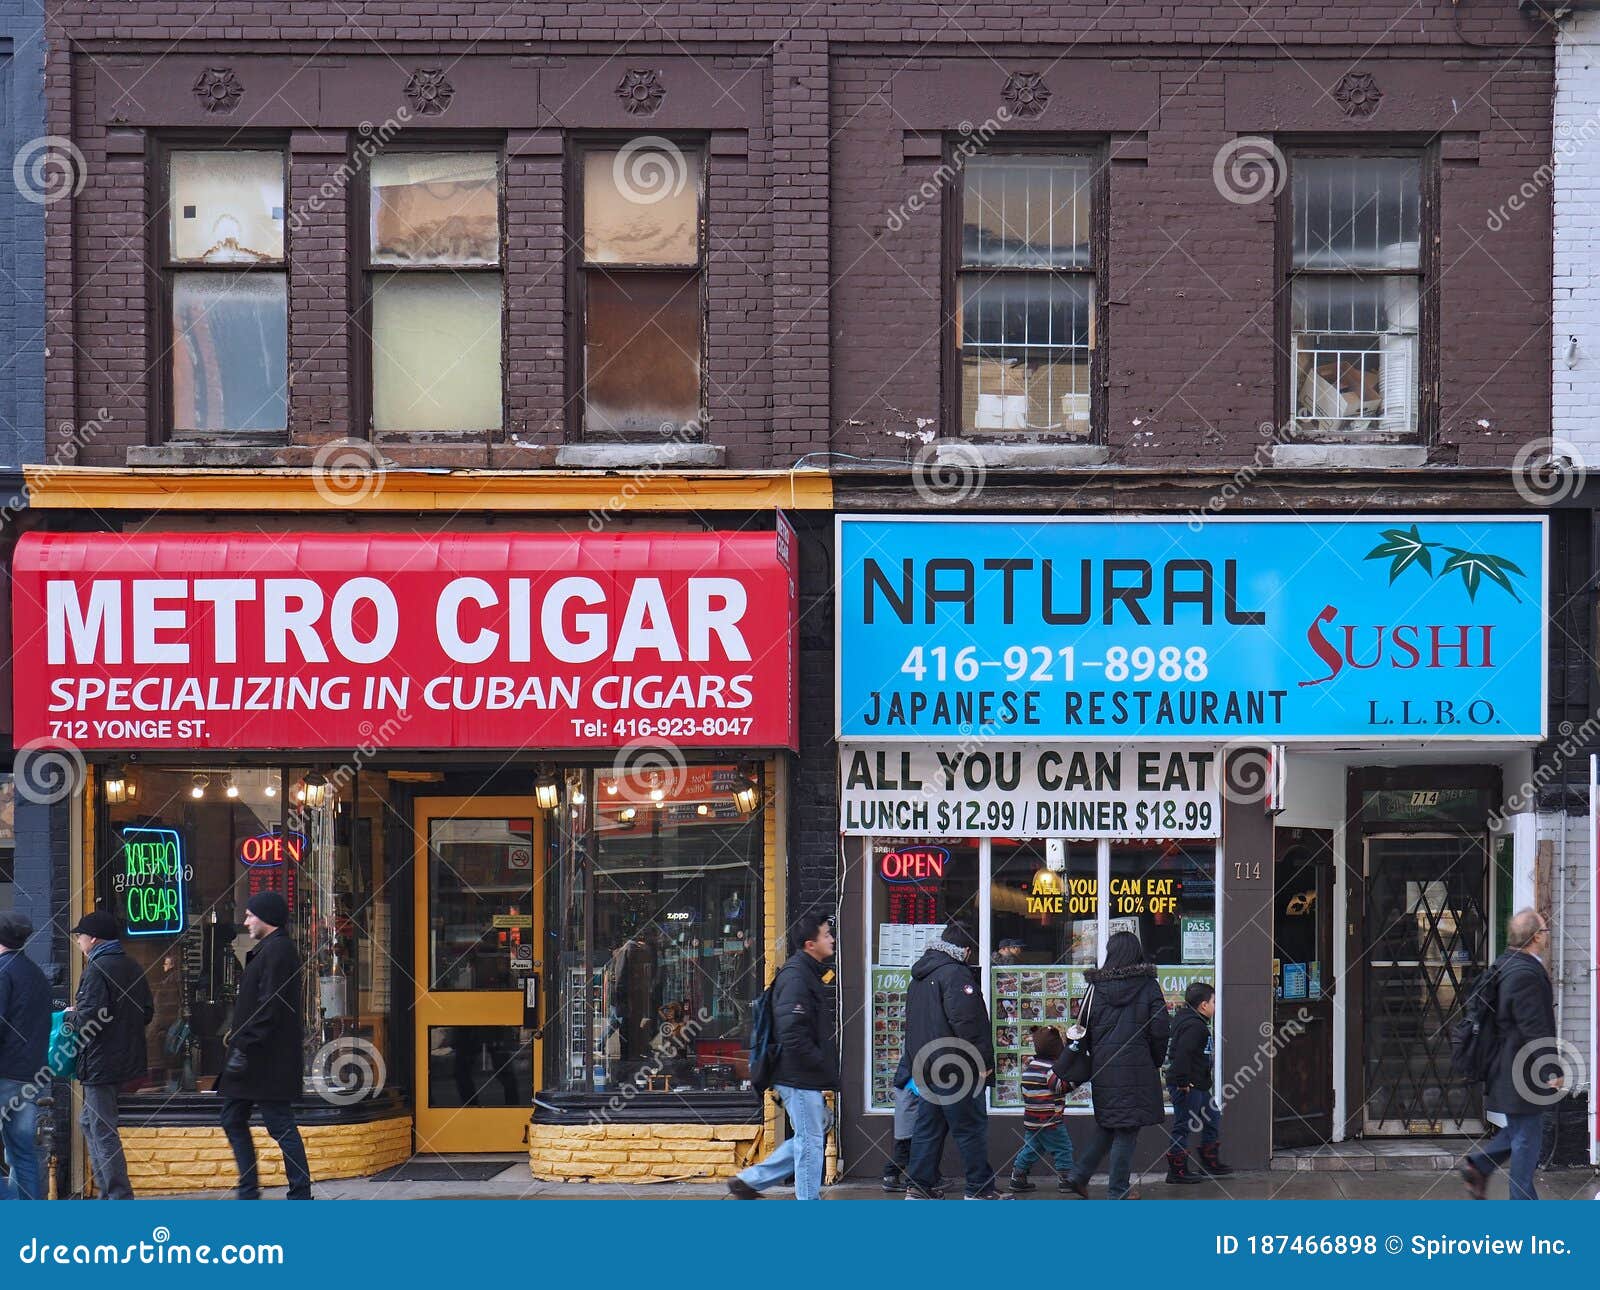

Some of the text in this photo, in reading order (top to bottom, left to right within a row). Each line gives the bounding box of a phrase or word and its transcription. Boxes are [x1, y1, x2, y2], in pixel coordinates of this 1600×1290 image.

[863, 558, 1267, 626] NATURAL
[46, 576, 753, 665] METRO CIGAR
[1299, 605, 1495, 687] SUSHI
[900, 645, 1209, 682] 416-921-8988
[47, 674, 754, 712] SPECIALIZING IN CUBAN CIGARS
[863, 690, 1288, 726] JAPANESE RESTAURANT
[49, 719, 210, 740] 712 YONGE ST.
[571, 717, 753, 738] Tel: 416-923-8047
[846, 750, 1215, 792] ALL YOU CAN EAT
[1412, 792, 1438, 805] 714
[846, 799, 1212, 835] LUNCH $12.99 / DINNER $18.99
[125, 841, 177, 876] METRO
[242, 837, 301, 862] OPEN
[882, 852, 944, 878] OPEN
[1234, 862, 1260, 879] 714
[1031, 879, 1061, 896] ALL
[1068, 879, 1097, 896] YOU
[1109, 879, 1142, 896] CAN
[1147, 879, 1174, 896] EAT
[127, 887, 179, 922] CIGAR
[1025, 897, 1178, 914] TAKE OUT 10% OFF
[1187, 922, 1211, 932] PASS
[876, 974, 906, 989] 10%
[1162, 975, 1187, 992] CAN
